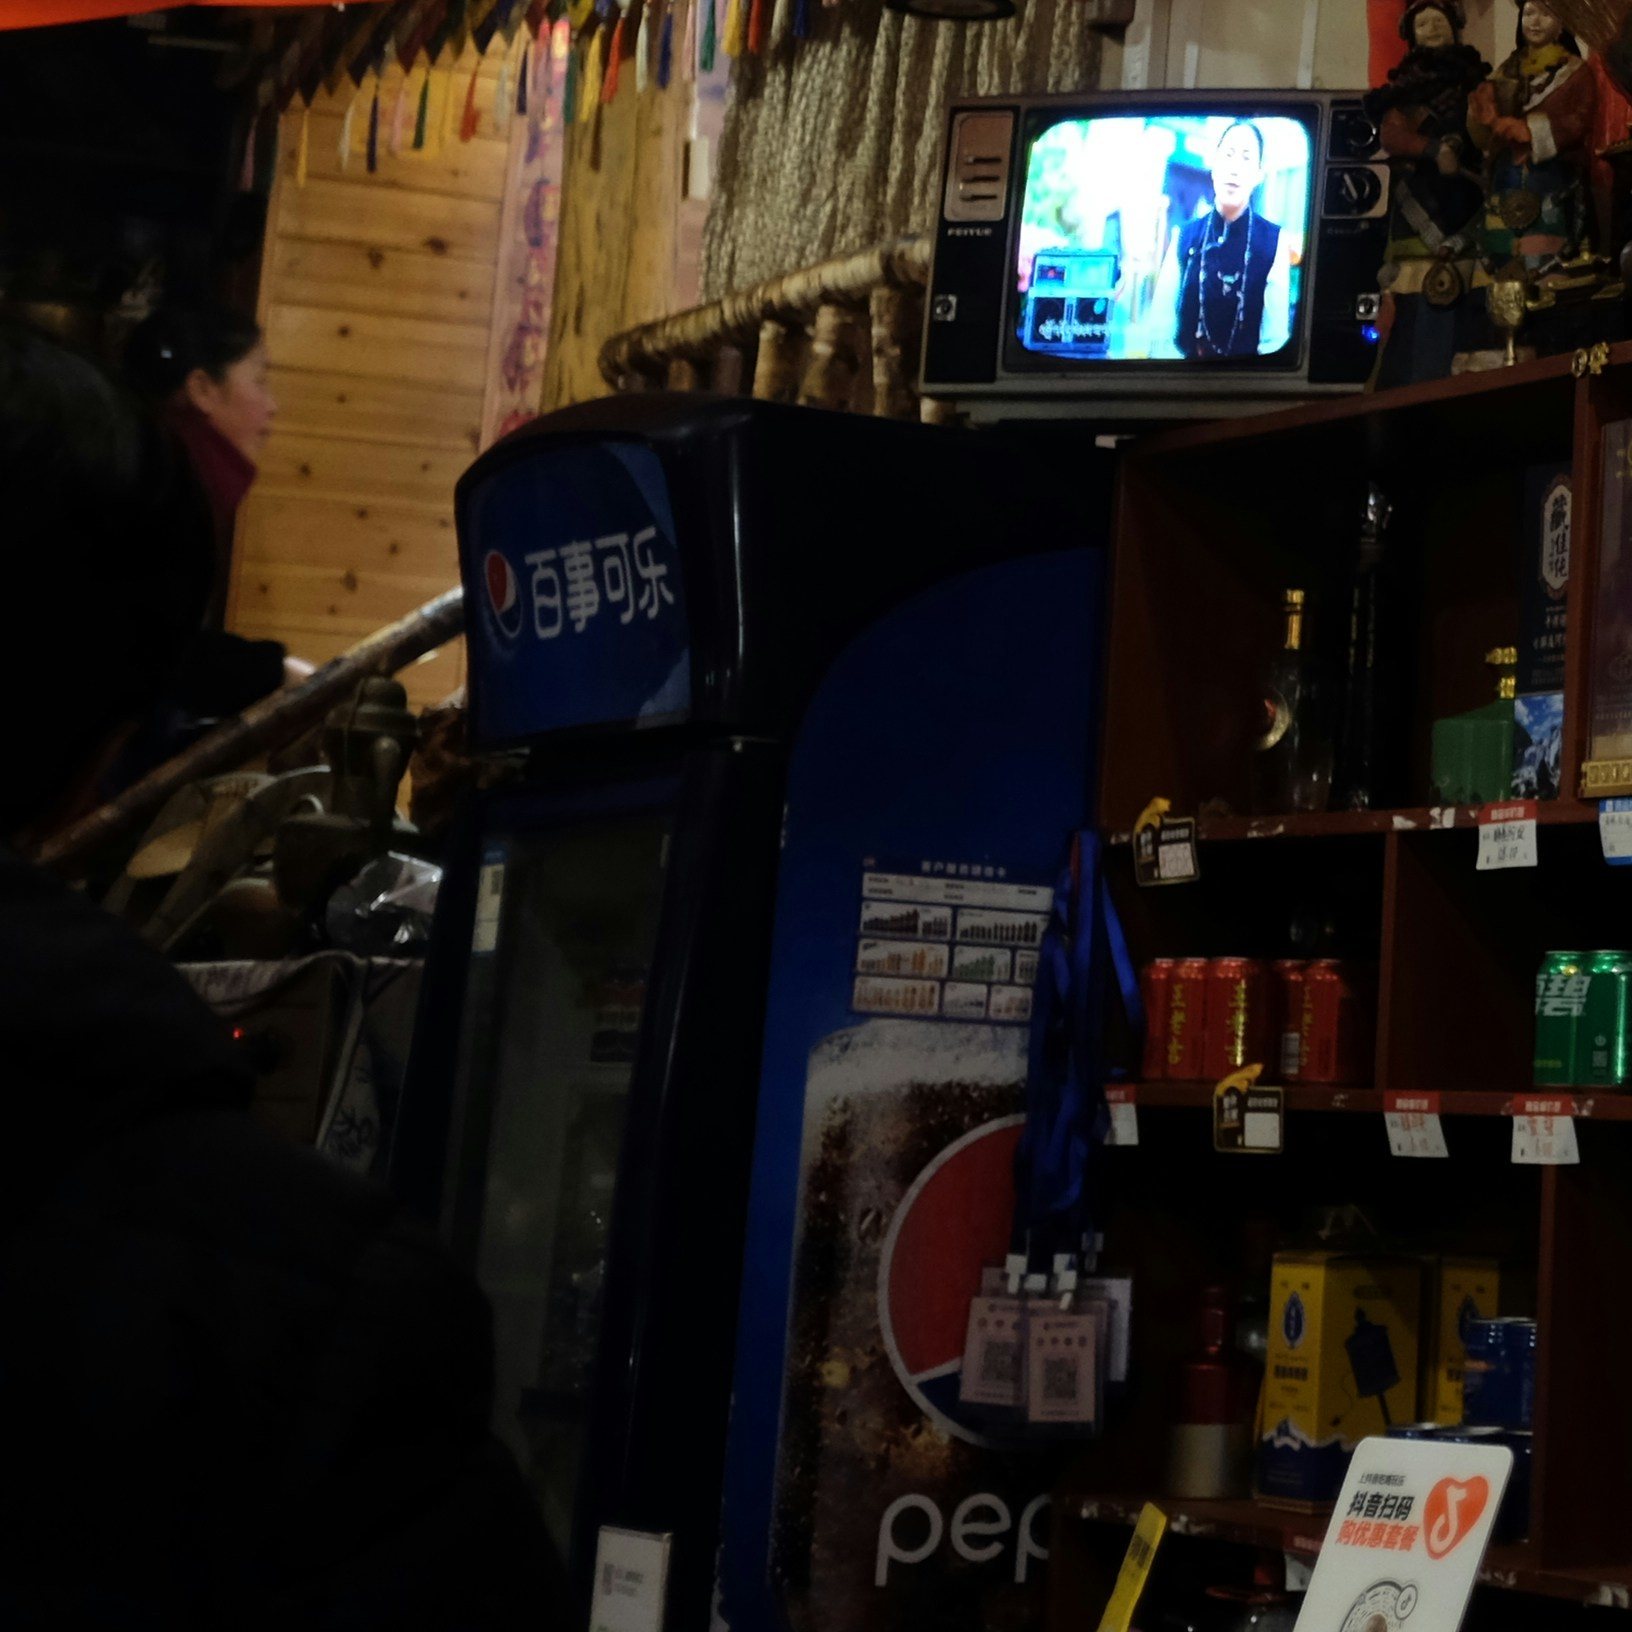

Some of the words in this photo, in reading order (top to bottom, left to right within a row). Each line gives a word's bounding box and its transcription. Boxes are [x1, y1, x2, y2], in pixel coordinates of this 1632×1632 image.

[523, 524, 675, 640] 百事可乐
[1347, 1490, 1415, 1522] 抖音扫码
[1335, 1519, 1420, 1552] 购优惠套餐
